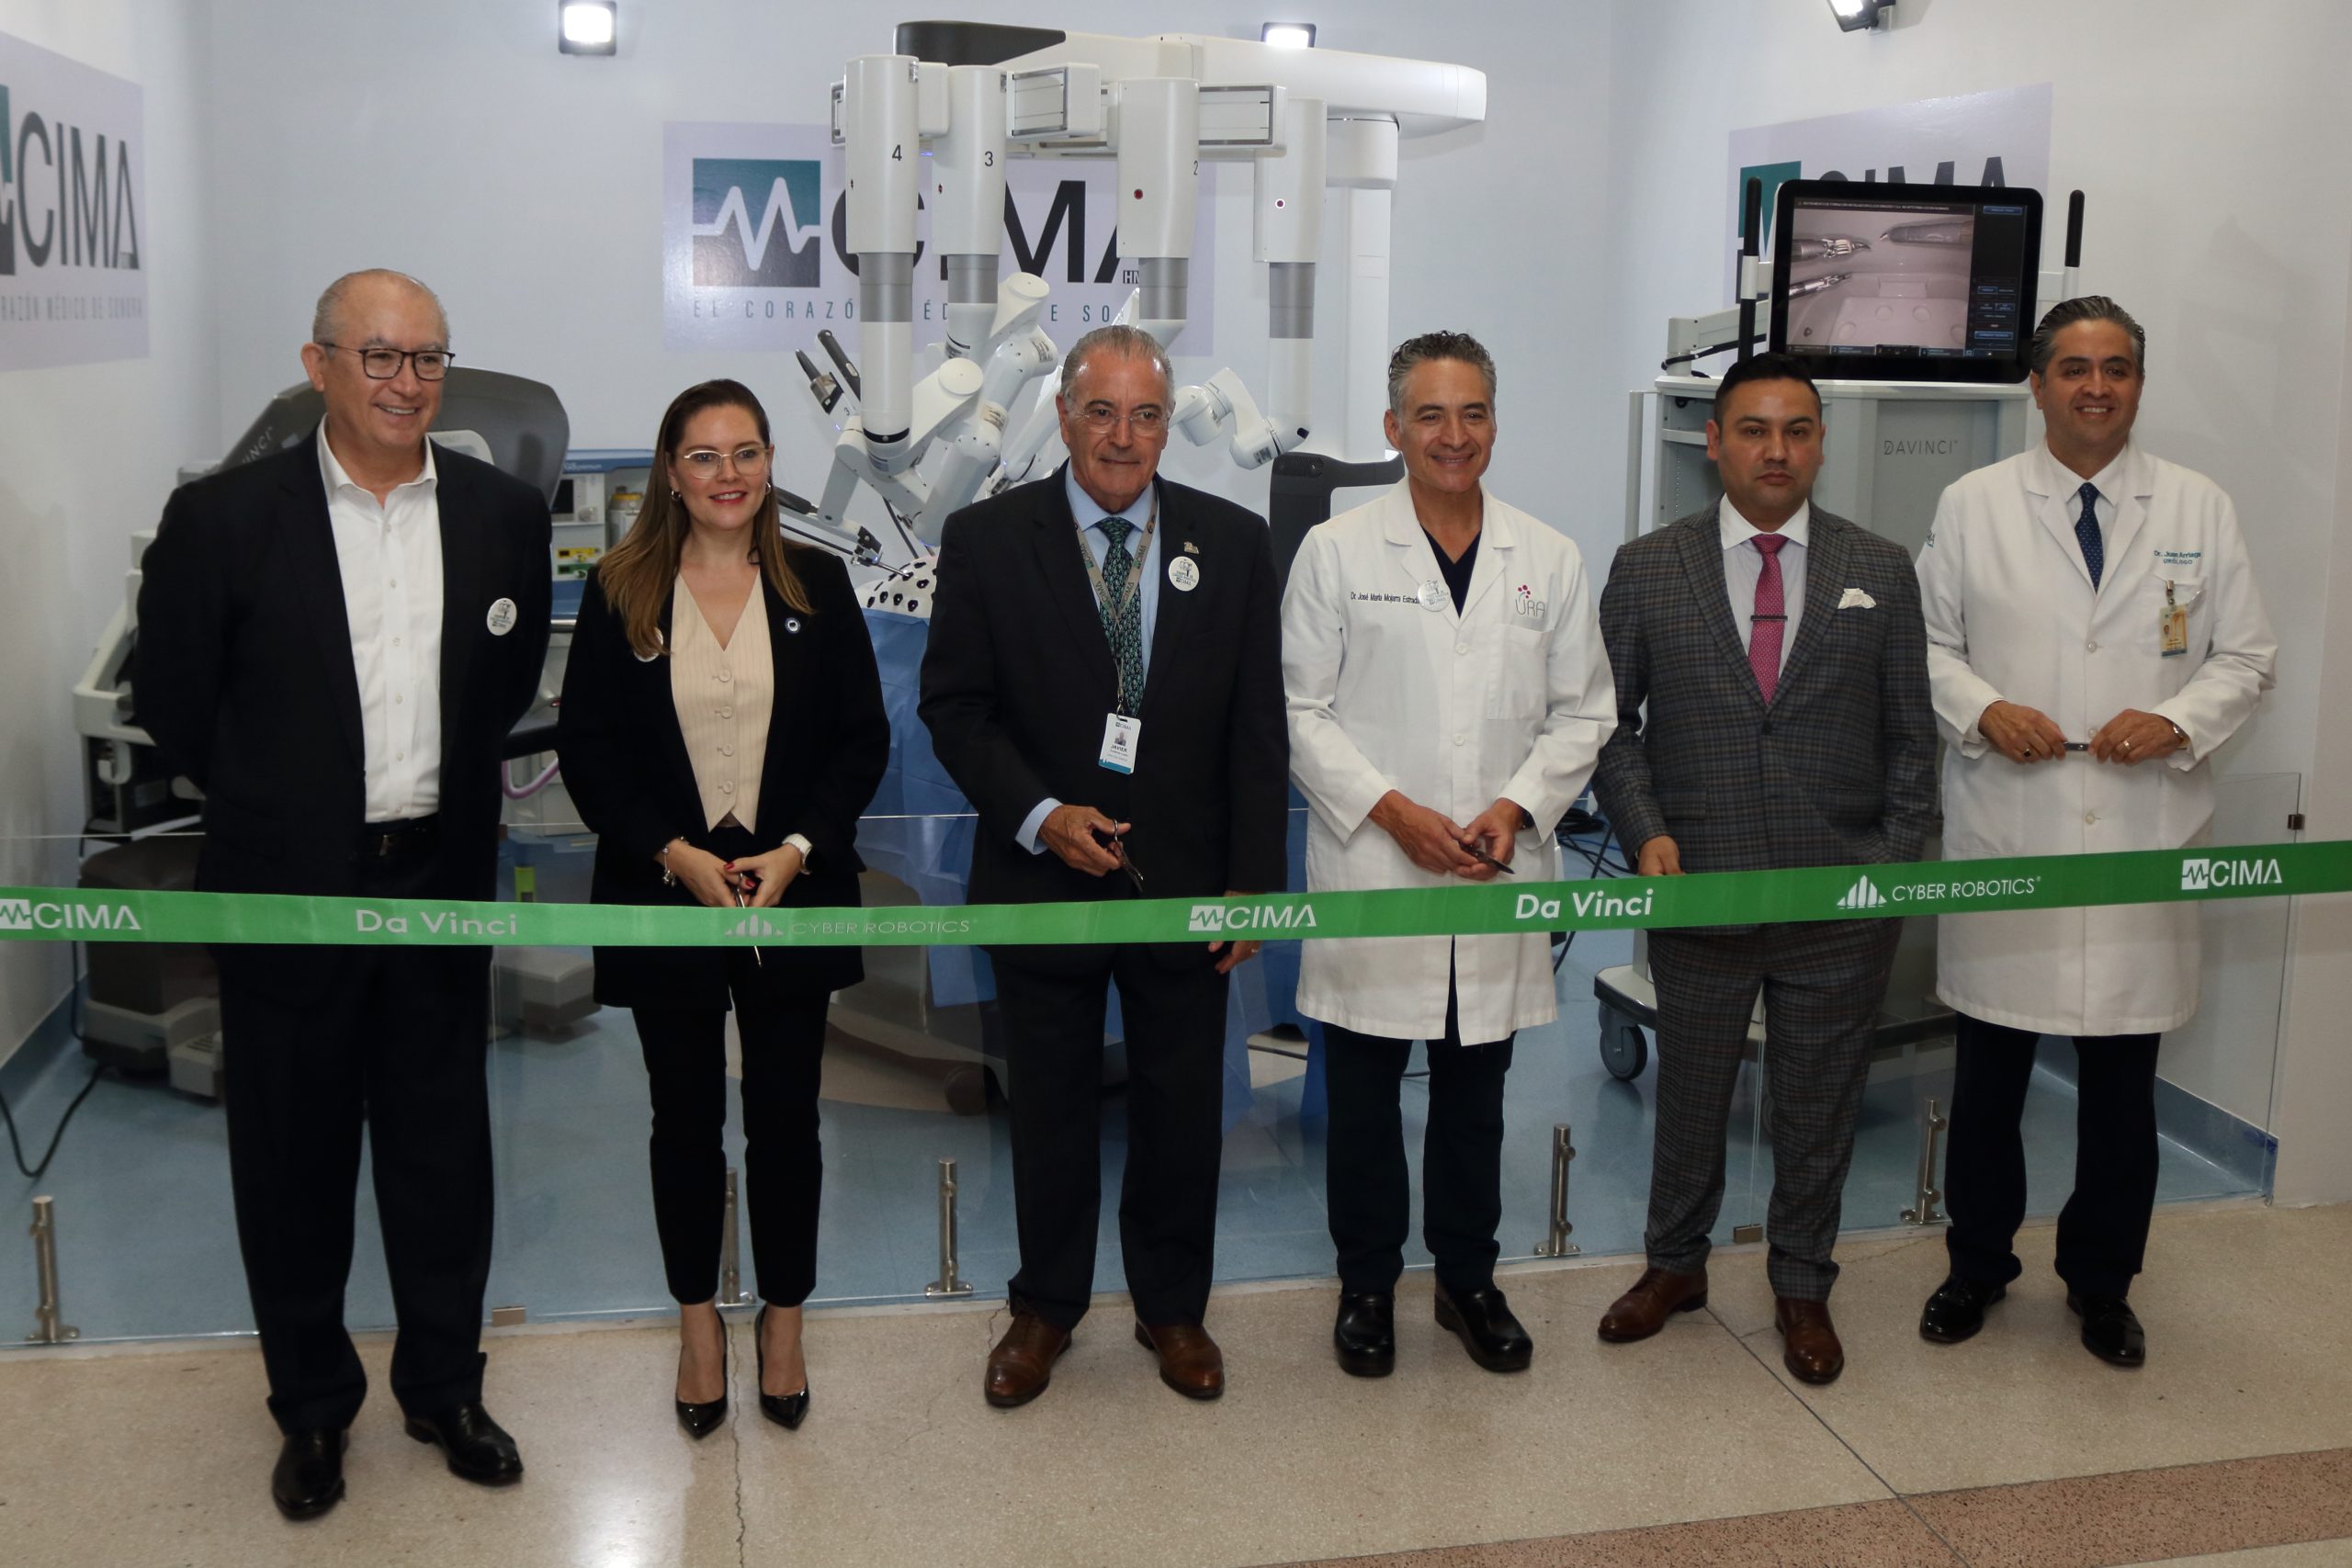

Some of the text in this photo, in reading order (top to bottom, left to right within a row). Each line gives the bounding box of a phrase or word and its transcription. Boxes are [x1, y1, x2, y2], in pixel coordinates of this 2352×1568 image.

[891, 144, 903, 162] 4
[984, 151, 994, 167] 3
[1193, 160, 1199, 175] 2
[17, 111, 140, 270] CIMA
[694, 298, 854, 320] EL CORAZÓ
[1883, 440, 1952, 456] DAVINCI
[2210, 858, 2282, 887] CIMA
[1516, 888, 1654, 919] Da Vinci
[1892, 884, 1946, 901] CYBER
[33, 902, 141, 930] CIMA
[356, 909, 516, 935] Da Vinci
[791, 920, 970, 934] CYBER ROBOTICS
[1226, 904, 1317, 930] CIMA
